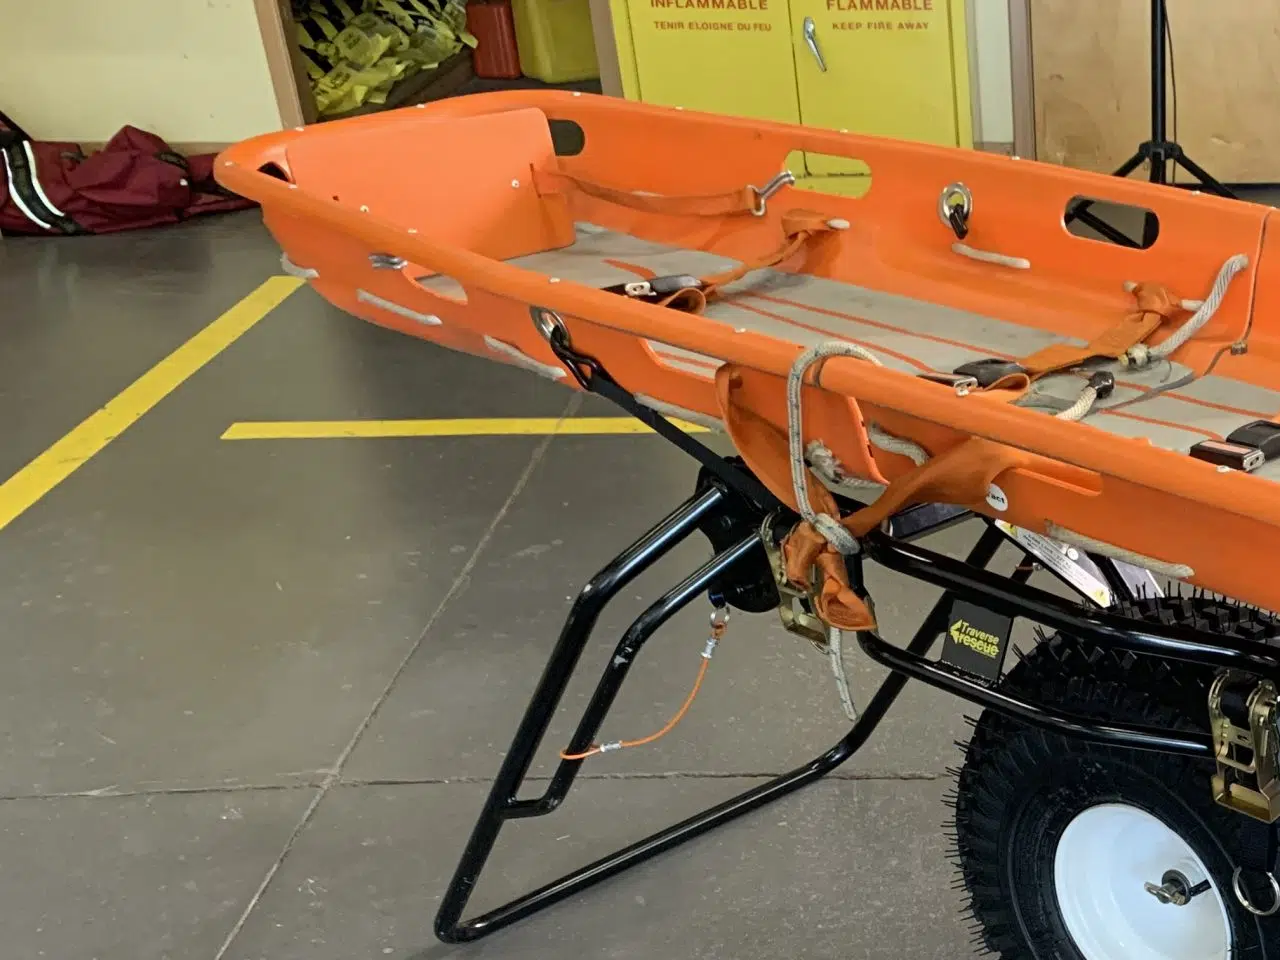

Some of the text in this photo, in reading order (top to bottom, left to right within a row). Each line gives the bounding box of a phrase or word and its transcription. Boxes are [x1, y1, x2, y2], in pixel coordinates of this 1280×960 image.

[650, 0, 768, 10] INFLAMMABLE
[826, 0, 933, 11] FLAMMABLE
[653, 21, 684, 30] TENIR
[737, 22, 751, 31] DU
[753, 22, 772, 32] FEU
[832, 21, 929, 30] KEEP FIRE AWAY
[961, 622, 1000, 645] Traverse
[959, 633, 999, 656] rescue
